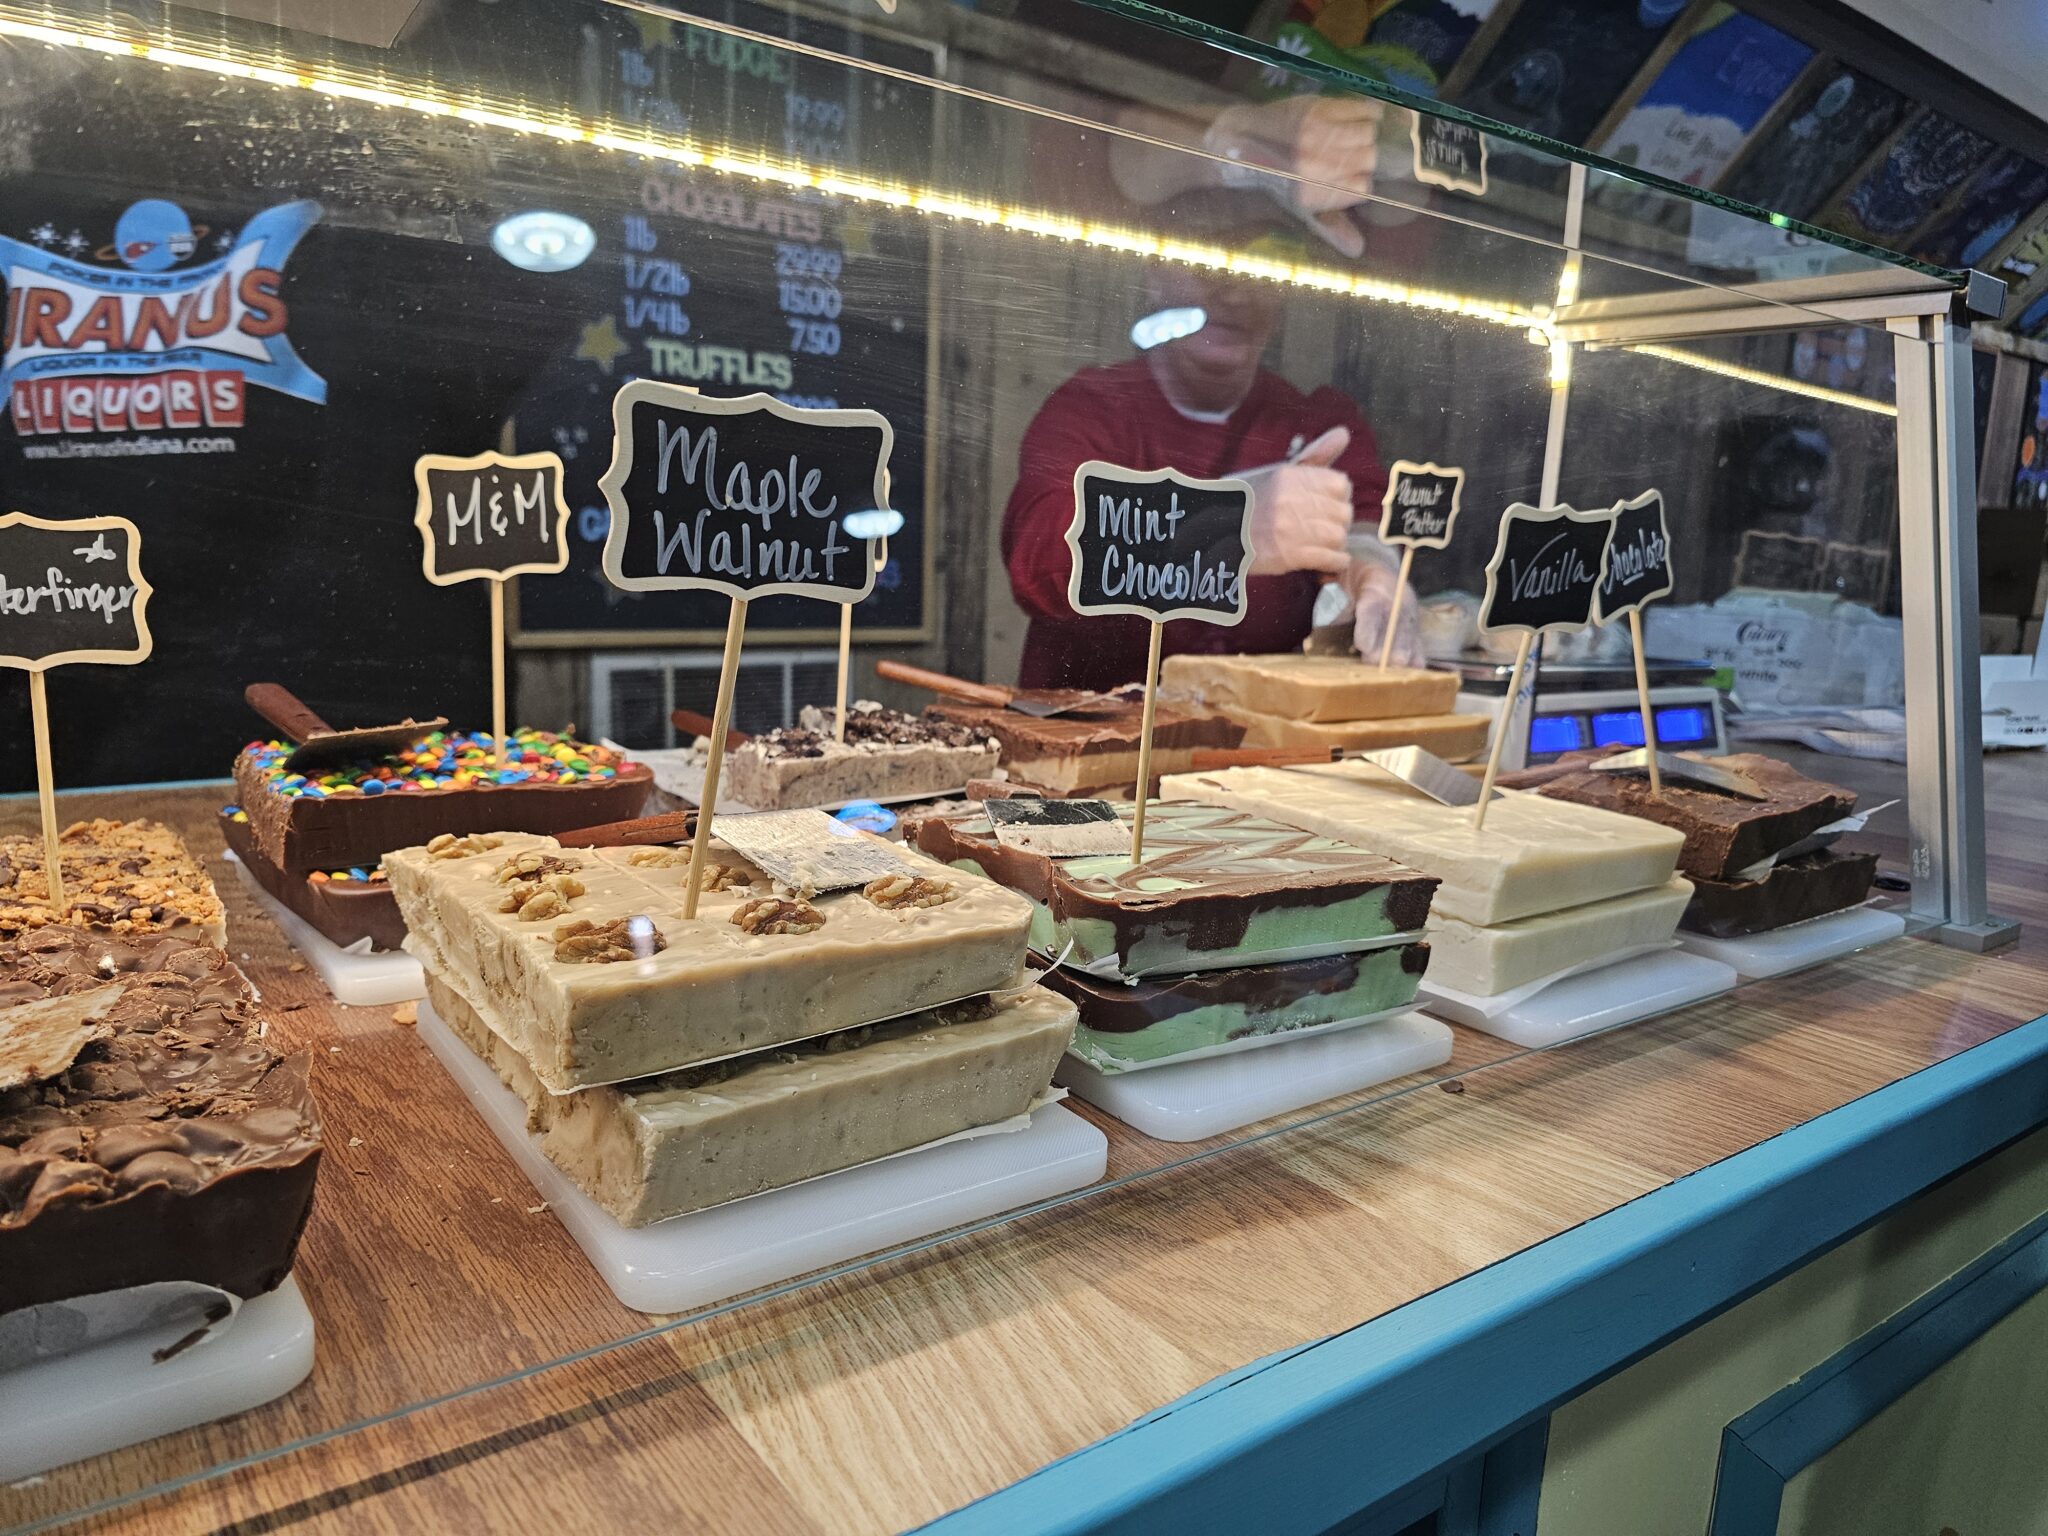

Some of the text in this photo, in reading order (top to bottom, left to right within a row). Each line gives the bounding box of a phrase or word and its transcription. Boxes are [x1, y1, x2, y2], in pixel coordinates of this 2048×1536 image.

[645, 336, 794, 390] TRUFFLES
[15, 378, 240, 420] LIQUORS
[656, 418, 838, 532] Maple
[446, 471, 550, 546] M&M
[1099, 492, 1186, 545] Mint
[652, 507, 851, 582] Walnut
[1101, 544, 1240, 605] Chocolate
[1510, 532, 1595, 602] Vanilla
